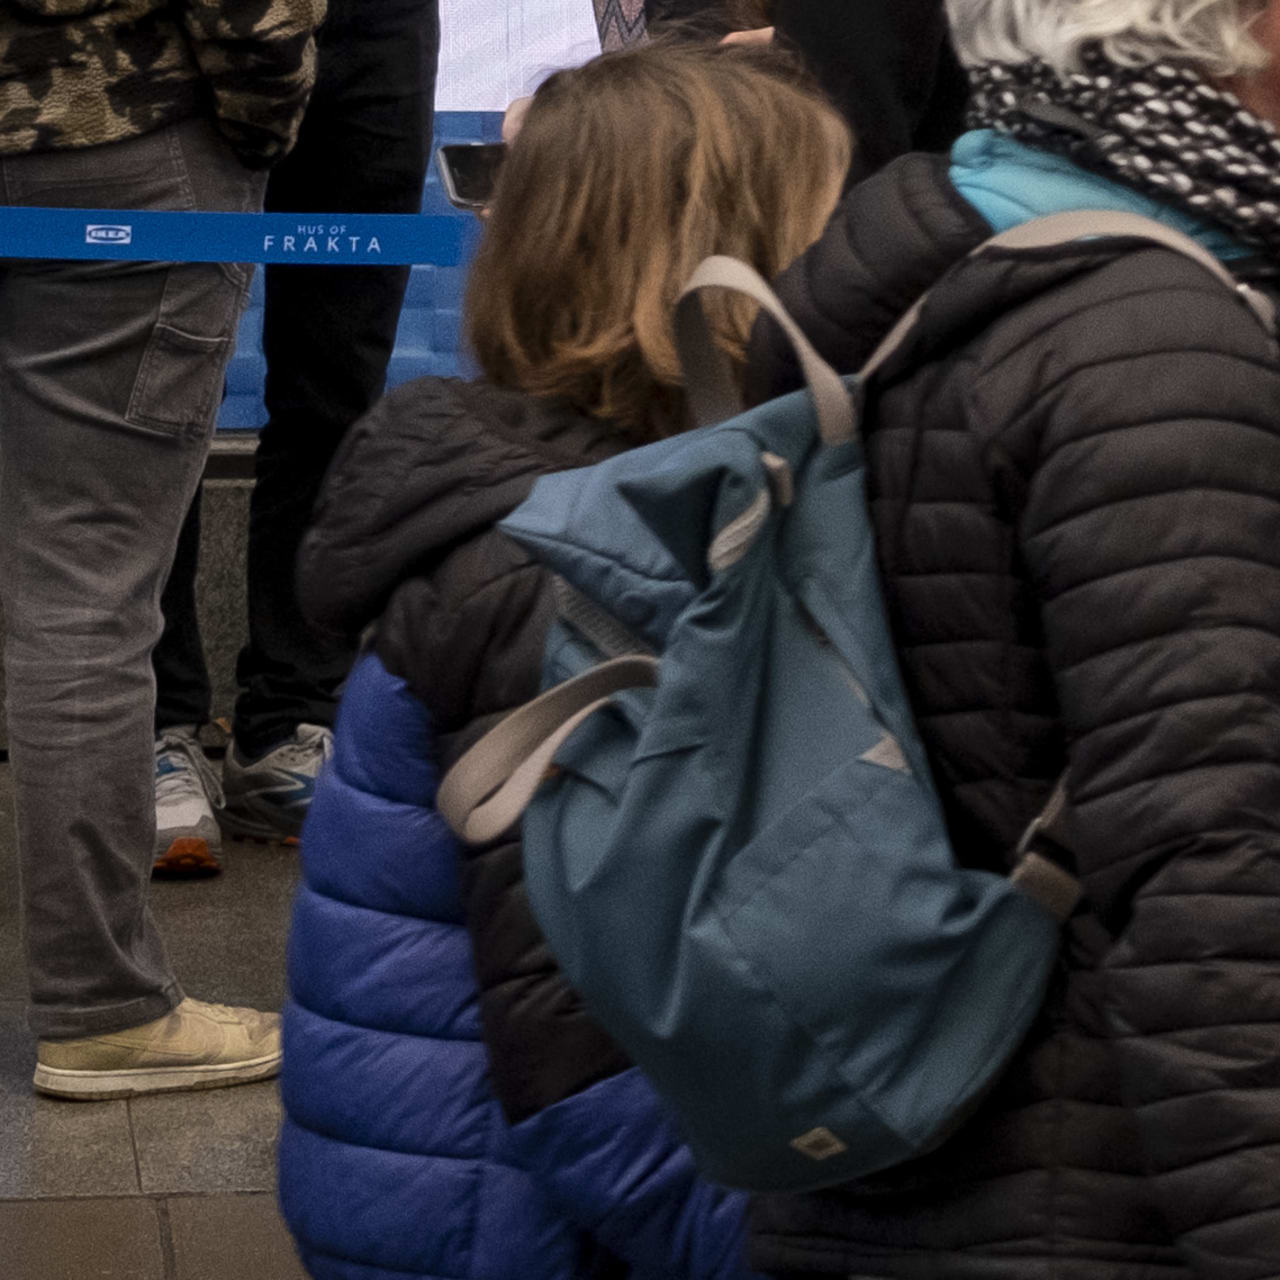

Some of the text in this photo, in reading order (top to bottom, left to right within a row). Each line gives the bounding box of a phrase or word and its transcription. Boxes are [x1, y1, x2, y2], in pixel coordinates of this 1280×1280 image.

[297, 224, 347, 235] HUS OF
[263, 235, 381, 253] FRAKTA
